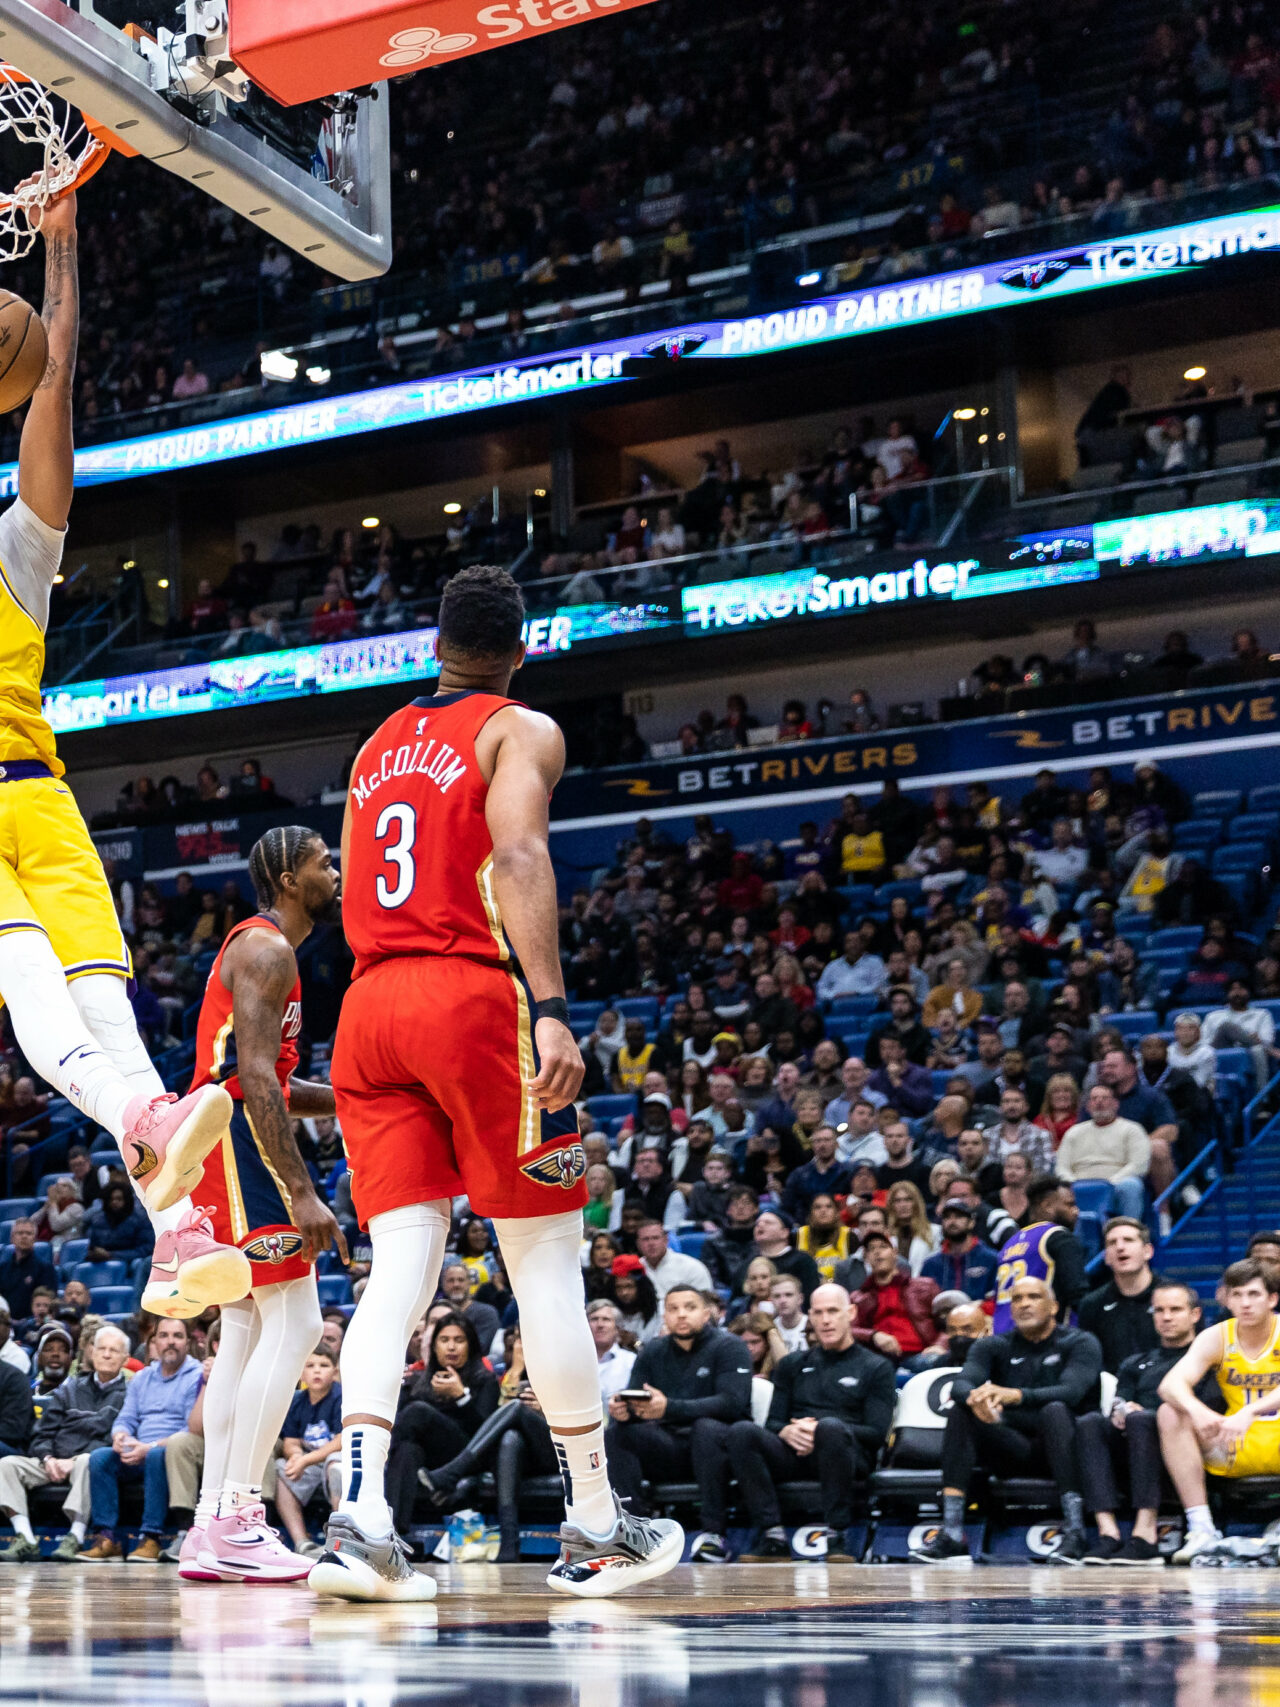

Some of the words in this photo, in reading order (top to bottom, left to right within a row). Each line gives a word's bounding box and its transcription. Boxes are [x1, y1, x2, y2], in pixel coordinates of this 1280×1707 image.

[476, 0, 621, 39] Sta
[721, 305, 826, 354] PROUD
[835, 272, 986, 332] PARTNER
[420, 350, 631, 416] TicketSmarter
[124, 432, 209, 471] PROUD
[216, 404, 338, 453] PARTNER
[1072, 697, 1277, 745] BETRIVE
[352, 739, 467, 809] McCOLLUM
[677, 742, 918, 794] BETRIVERS
[375, 801, 417, 911] 3
